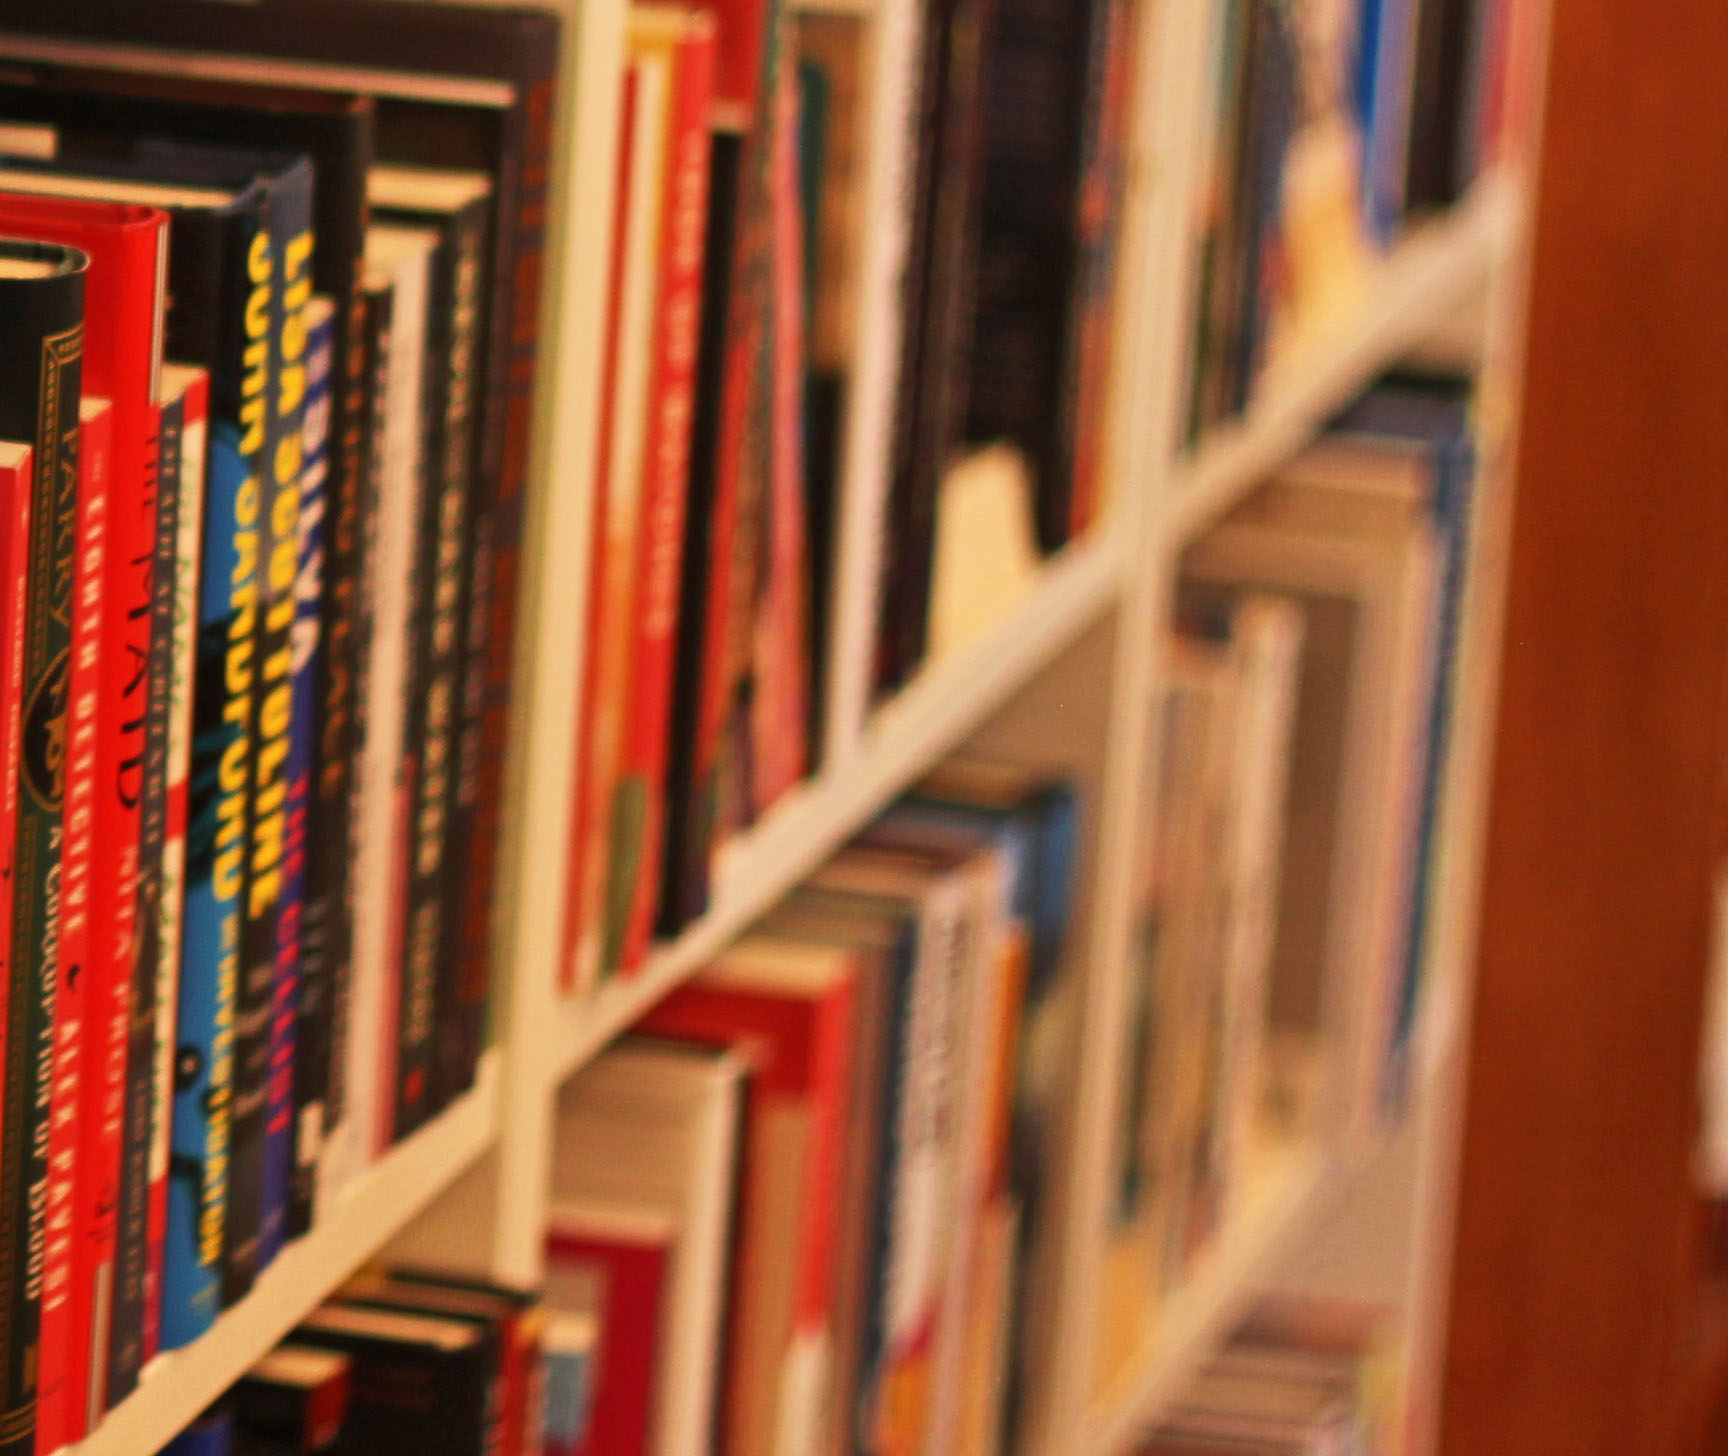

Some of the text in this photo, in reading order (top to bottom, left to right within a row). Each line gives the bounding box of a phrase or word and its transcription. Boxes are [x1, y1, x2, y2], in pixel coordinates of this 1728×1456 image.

[276, 233, 314, 417] LISA
[62, 494, 106, 941] EIGHTH DETECTIVE
[115, 549, 155, 812] MAID
[52, 1018, 81, 1129] ALEX
